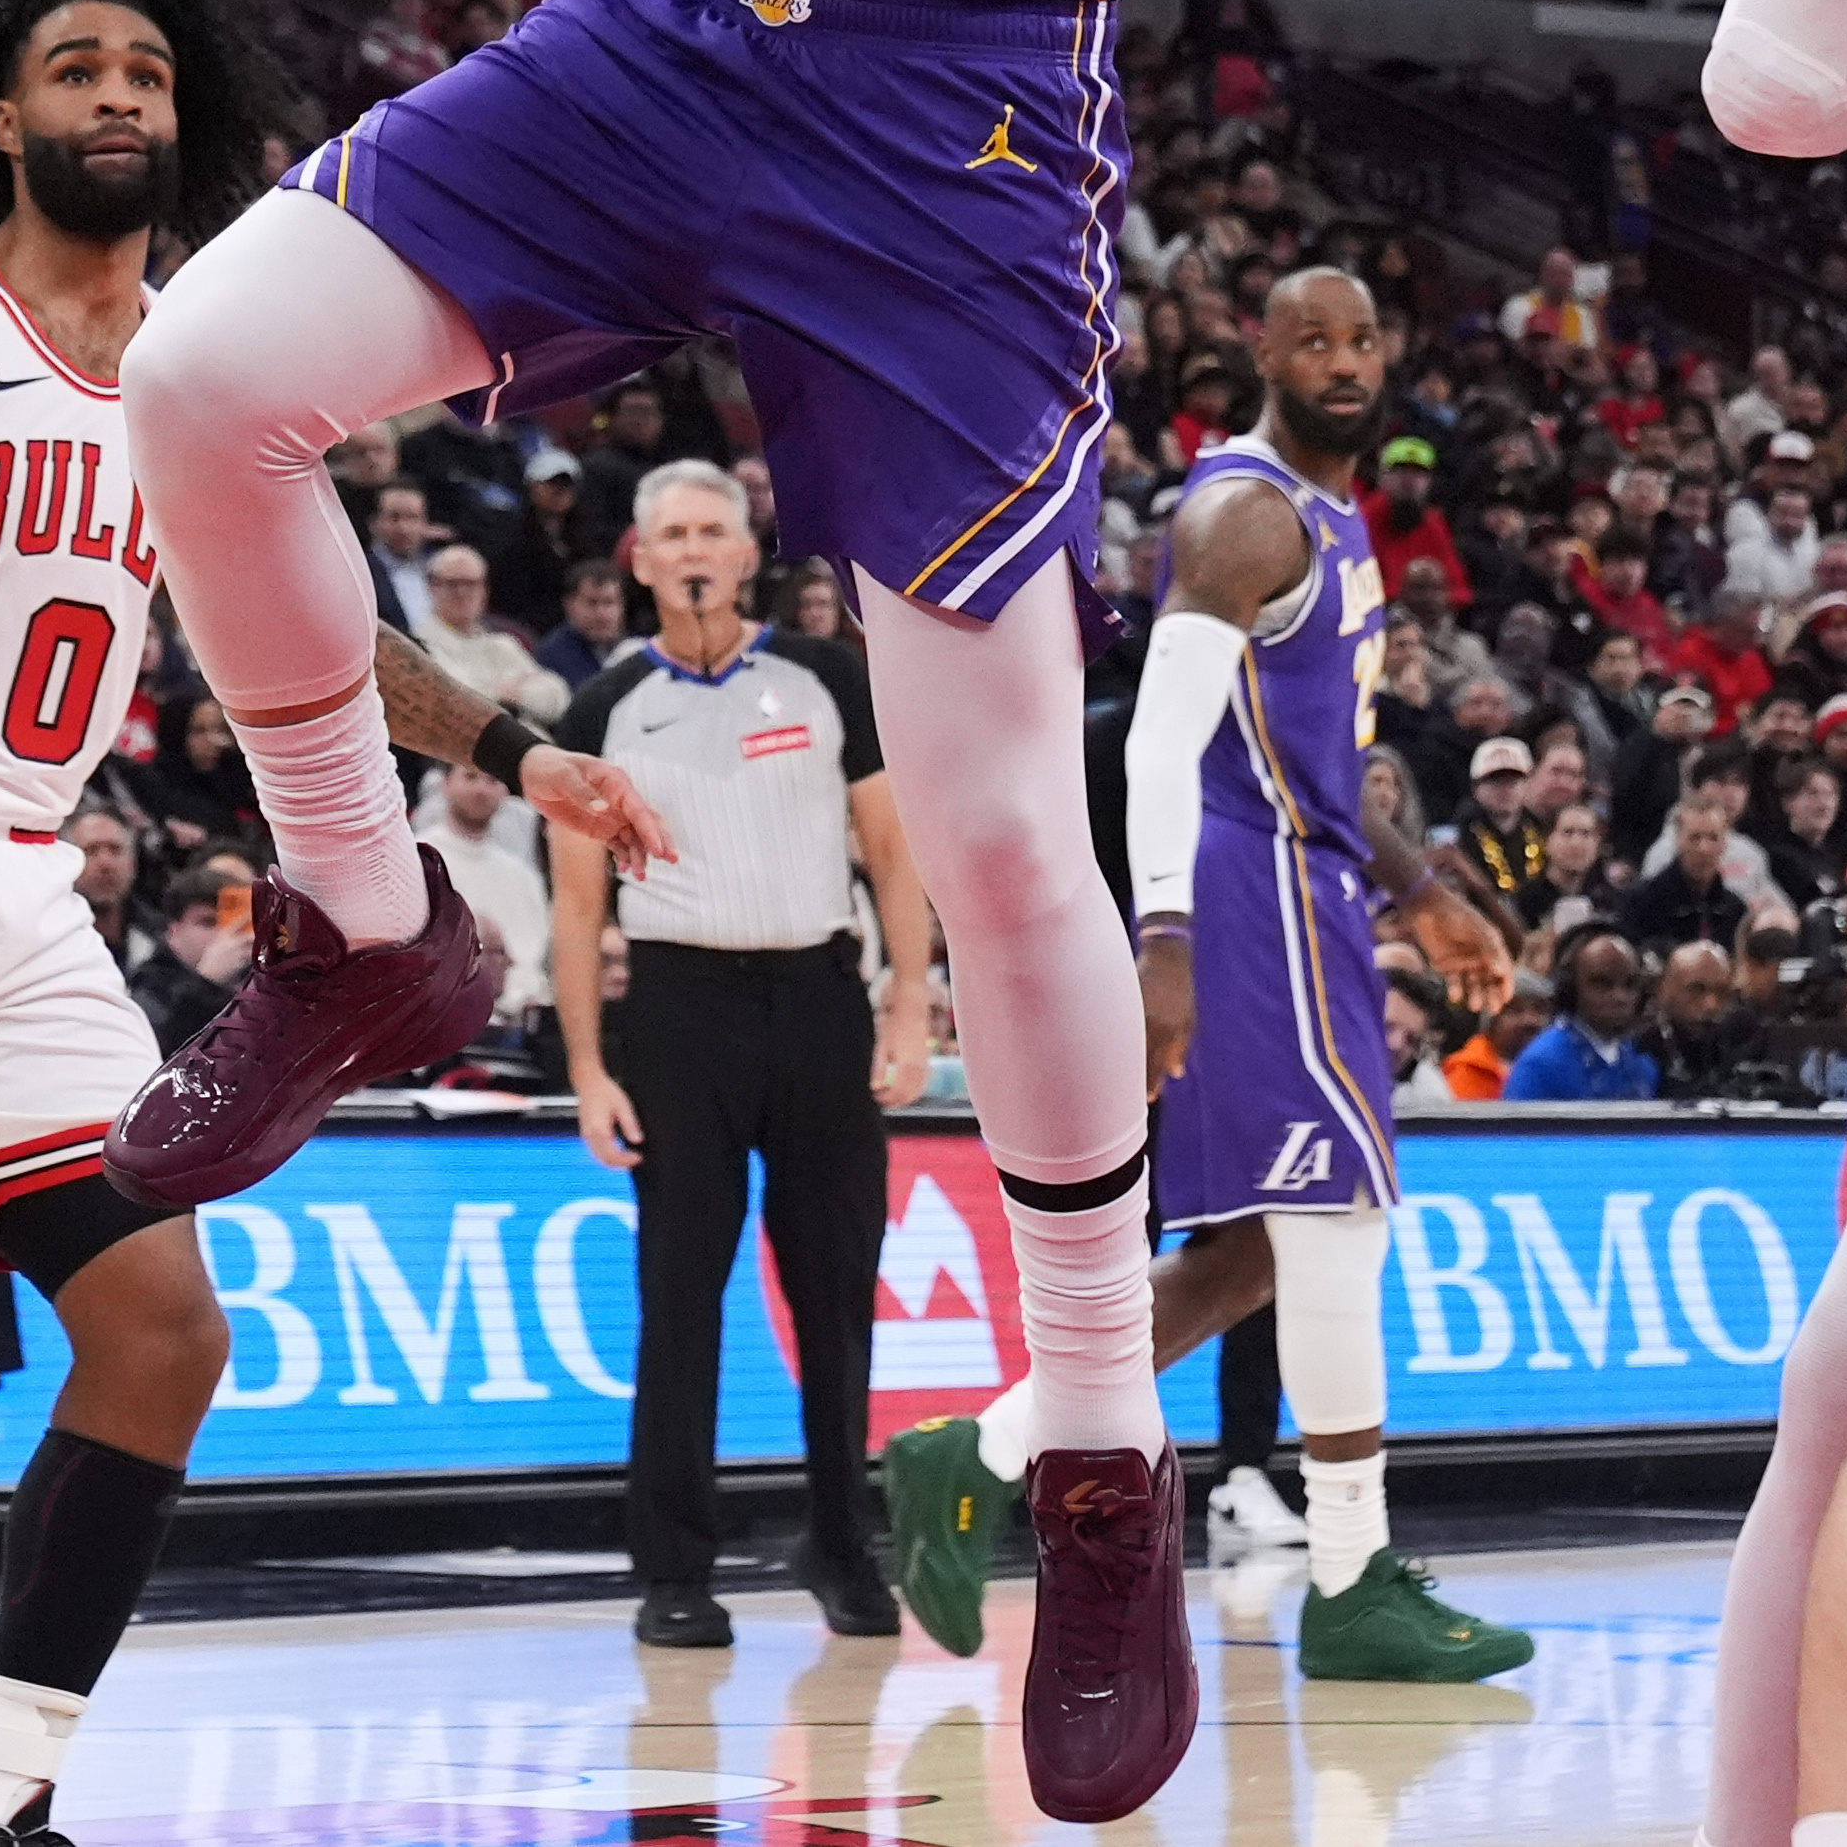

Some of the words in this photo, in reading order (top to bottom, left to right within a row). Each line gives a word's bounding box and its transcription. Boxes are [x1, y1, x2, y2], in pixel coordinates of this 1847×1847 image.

[1, 596, 117, 766] 0
[1254, 1120, 1334, 1191] LA
[197, 1198, 639, 1410] BMO
[1391, 1188, 1800, 1373] BMO
